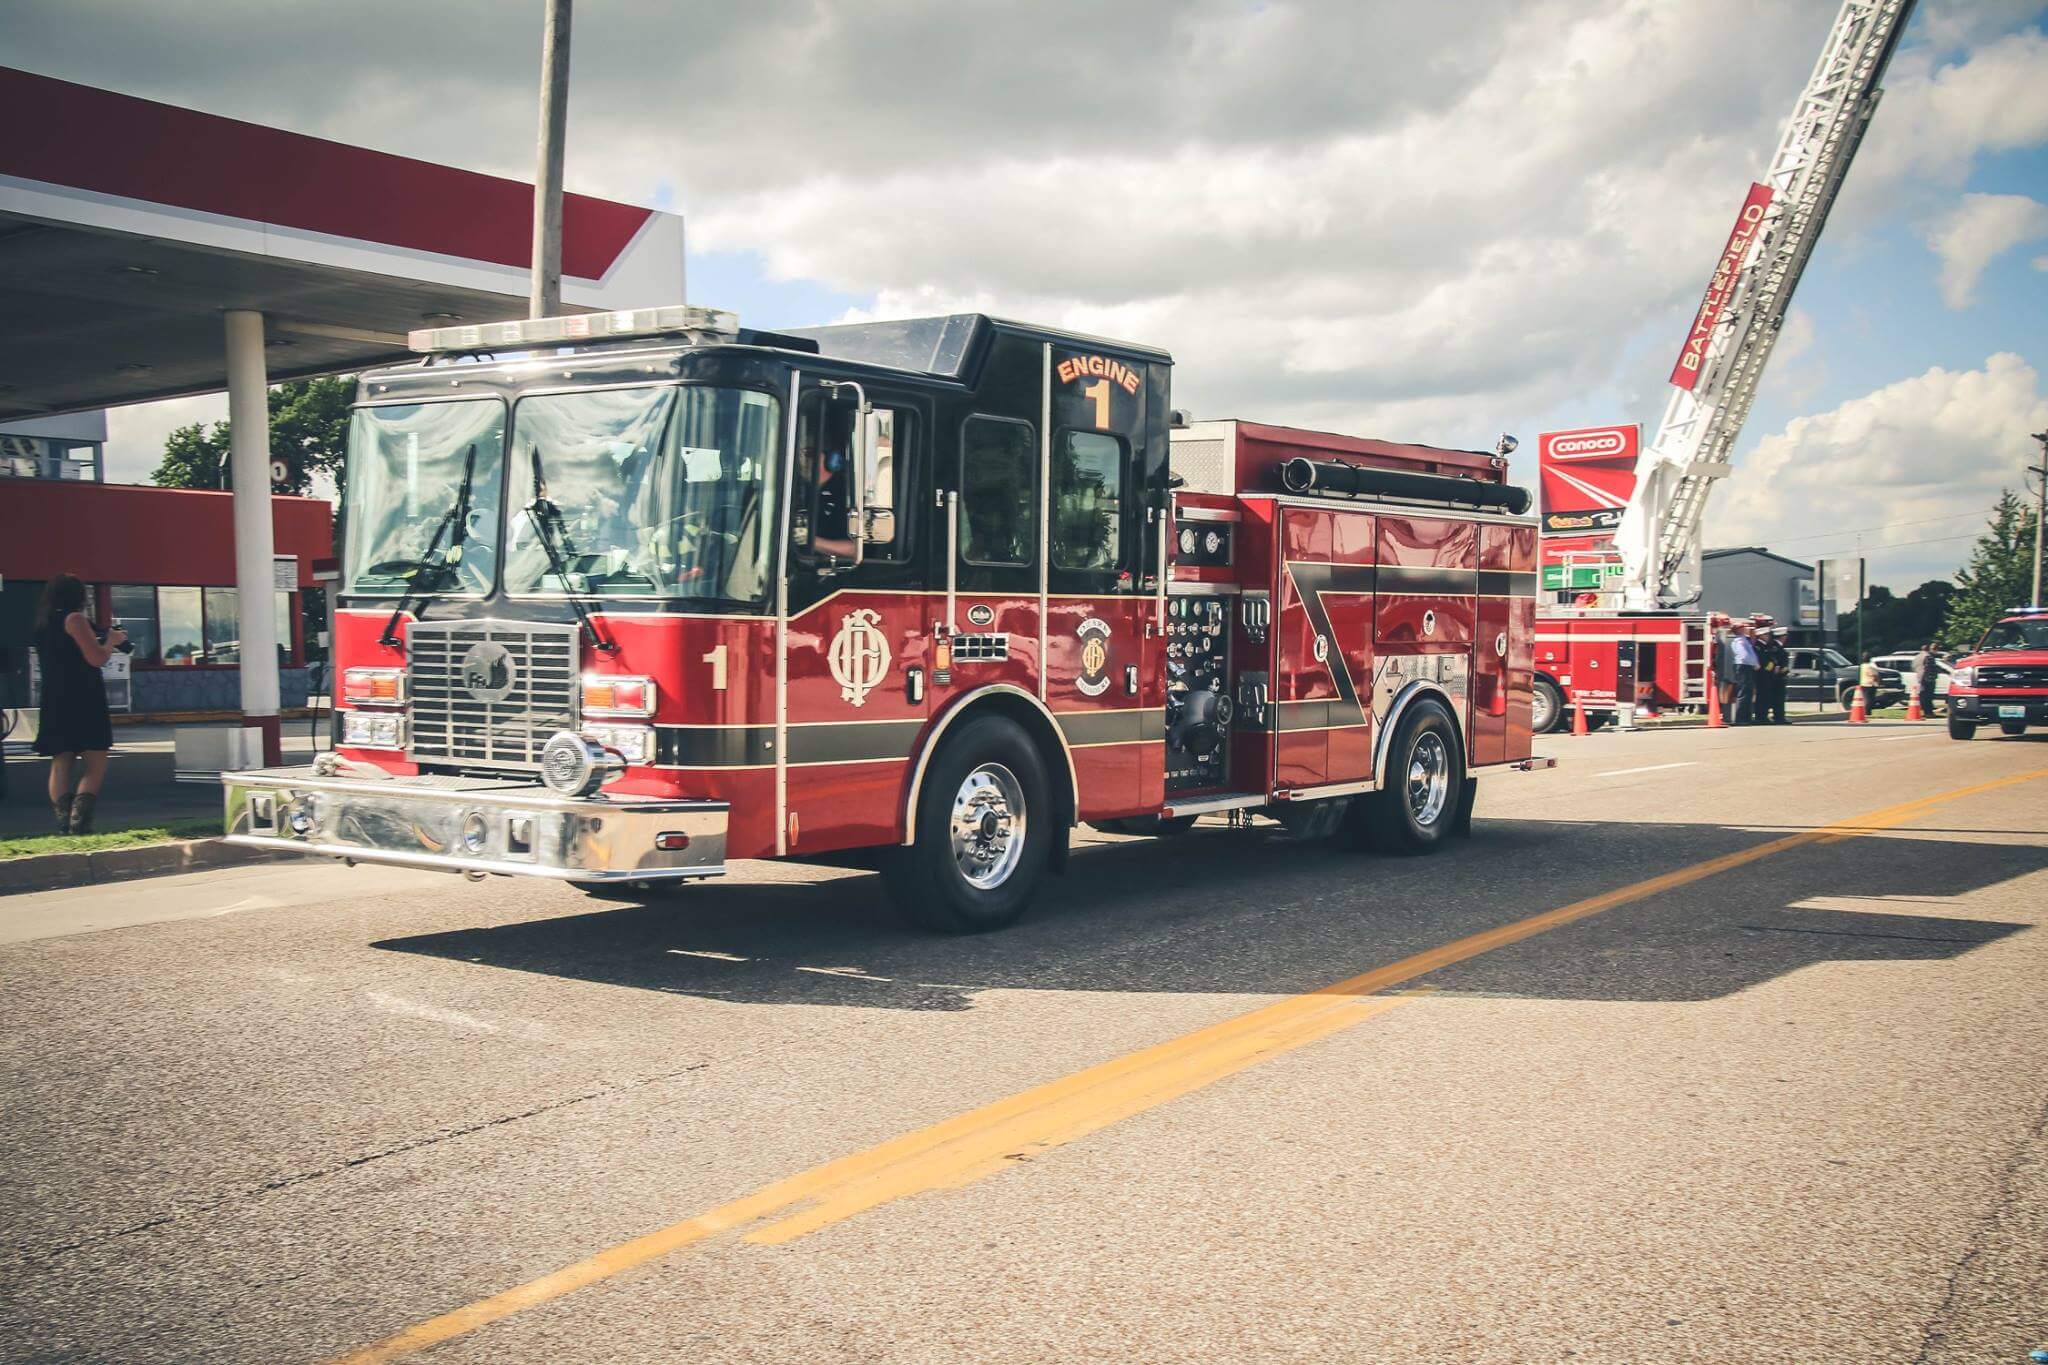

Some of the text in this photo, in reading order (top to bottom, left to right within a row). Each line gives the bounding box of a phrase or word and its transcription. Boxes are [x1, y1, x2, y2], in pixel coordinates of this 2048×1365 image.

[1682, 204, 1764, 371] BATTLEFIELD
[1057, 355, 1140, 395] ENGINE
[1085, 379, 1110, 430] 1
[702, 645, 728, 690] 1
